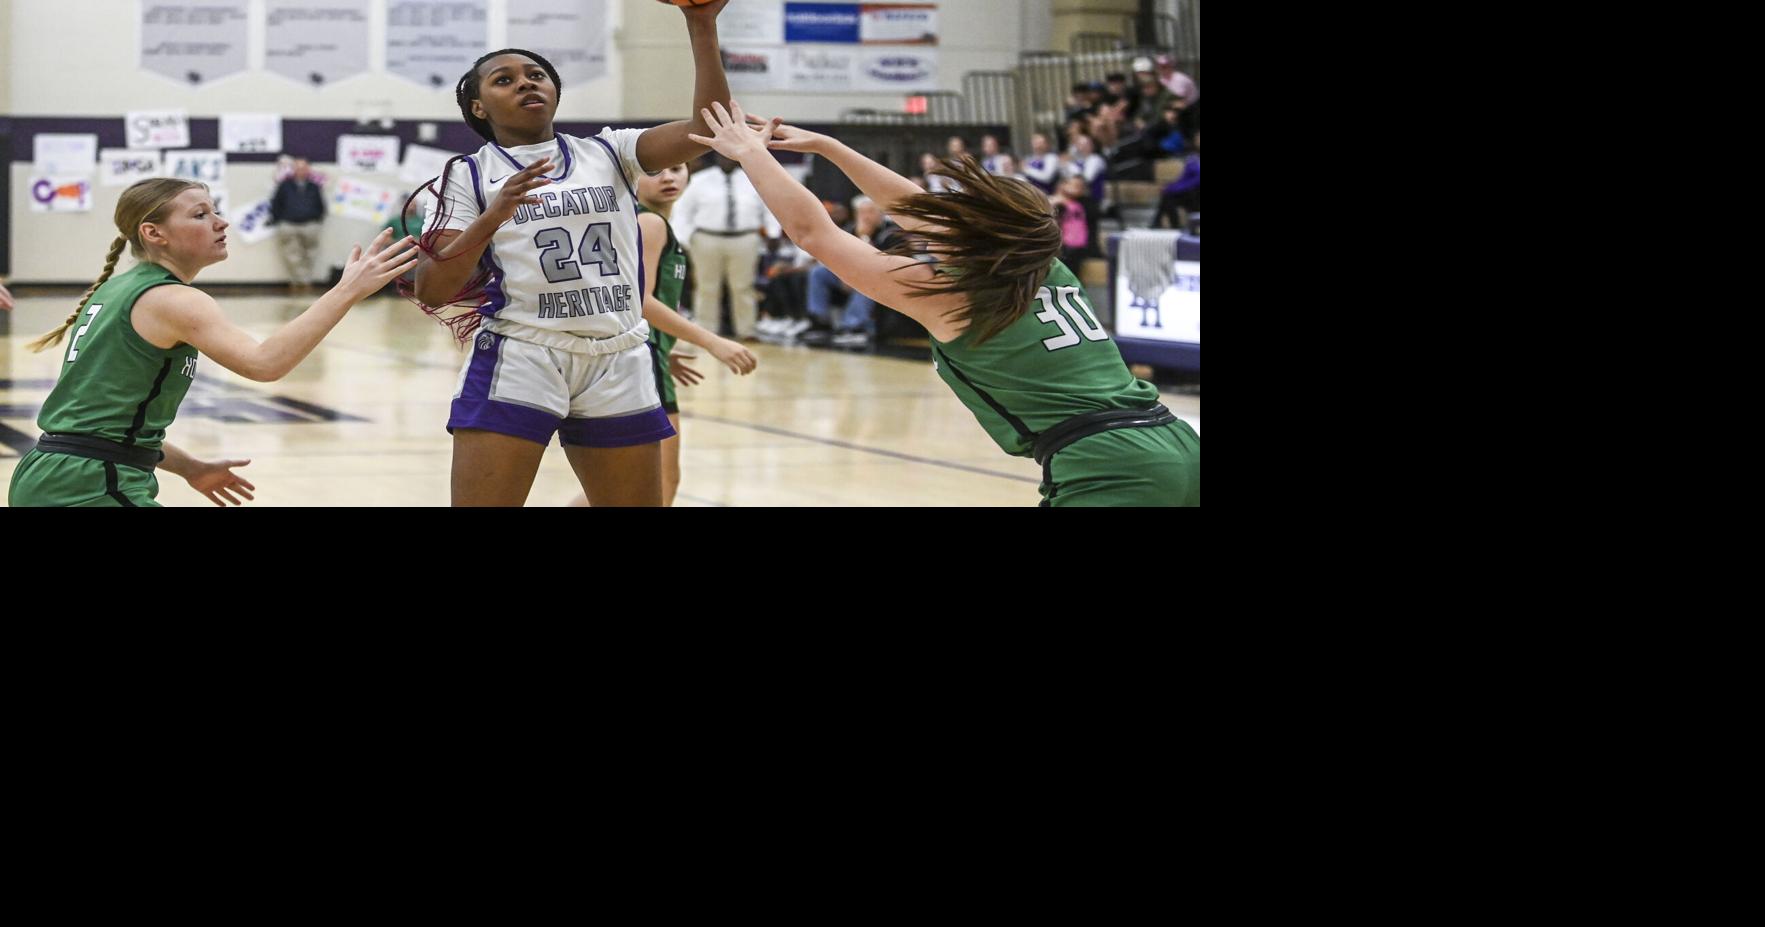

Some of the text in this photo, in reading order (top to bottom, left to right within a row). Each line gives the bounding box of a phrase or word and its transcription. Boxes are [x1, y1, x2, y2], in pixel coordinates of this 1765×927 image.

[533, 222, 621, 284] 24
[538, 284, 632, 319] HERITAGE
[1033, 285, 1109, 352] 30
[66, 303, 104, 363] 2
